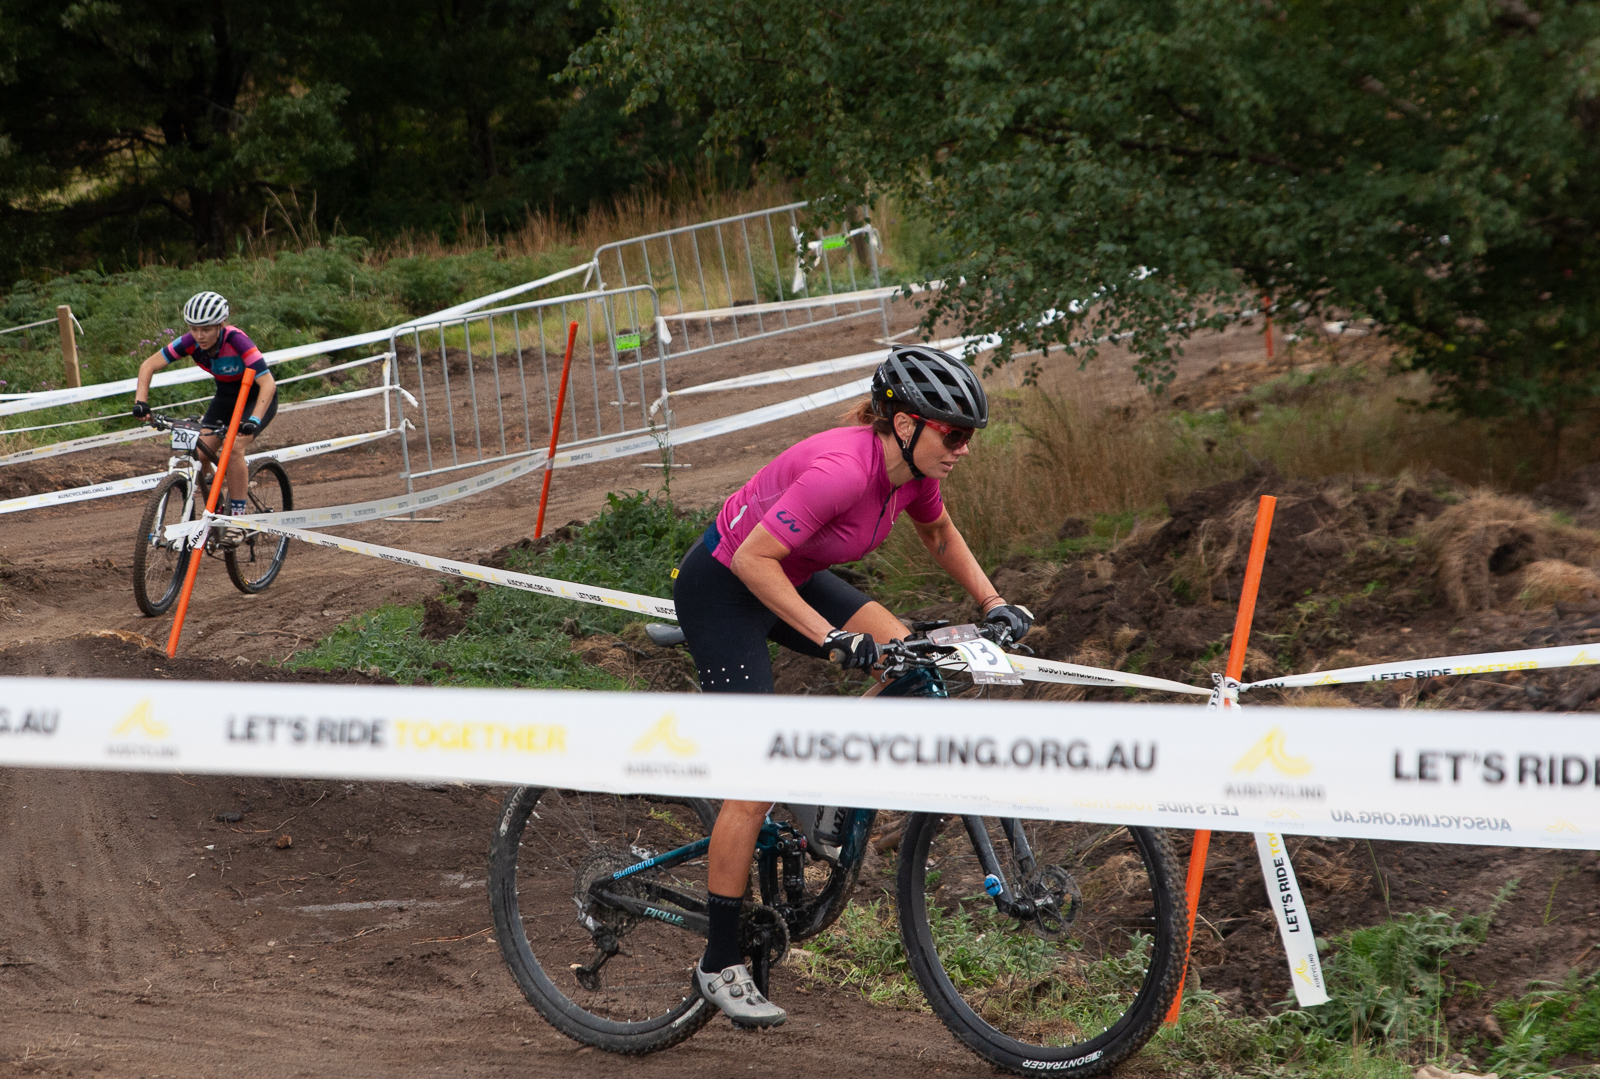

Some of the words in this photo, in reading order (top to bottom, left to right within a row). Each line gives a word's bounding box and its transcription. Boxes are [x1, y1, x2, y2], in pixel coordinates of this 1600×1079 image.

[173, 431, 196, 444] 207
[226, 713, 309, 745] LET'S
[315, 715, 388, 747] RIDE
[394, 718, 568, 753] TOGETHER
[768, 729, 1159, 774] AUSCYCLING.ORG.AU
[1393, 748, 1507, 785] LET'S
[1518, 752, 1600, 787] RID
[1273, 857, 1291, 893] RIDE
[1281, 893, 1301, 933] LET'S
[1308, 953, 1322, 989] AUSCYCLING
[1022, 1052, 1098, 1071] BONTRAGER
